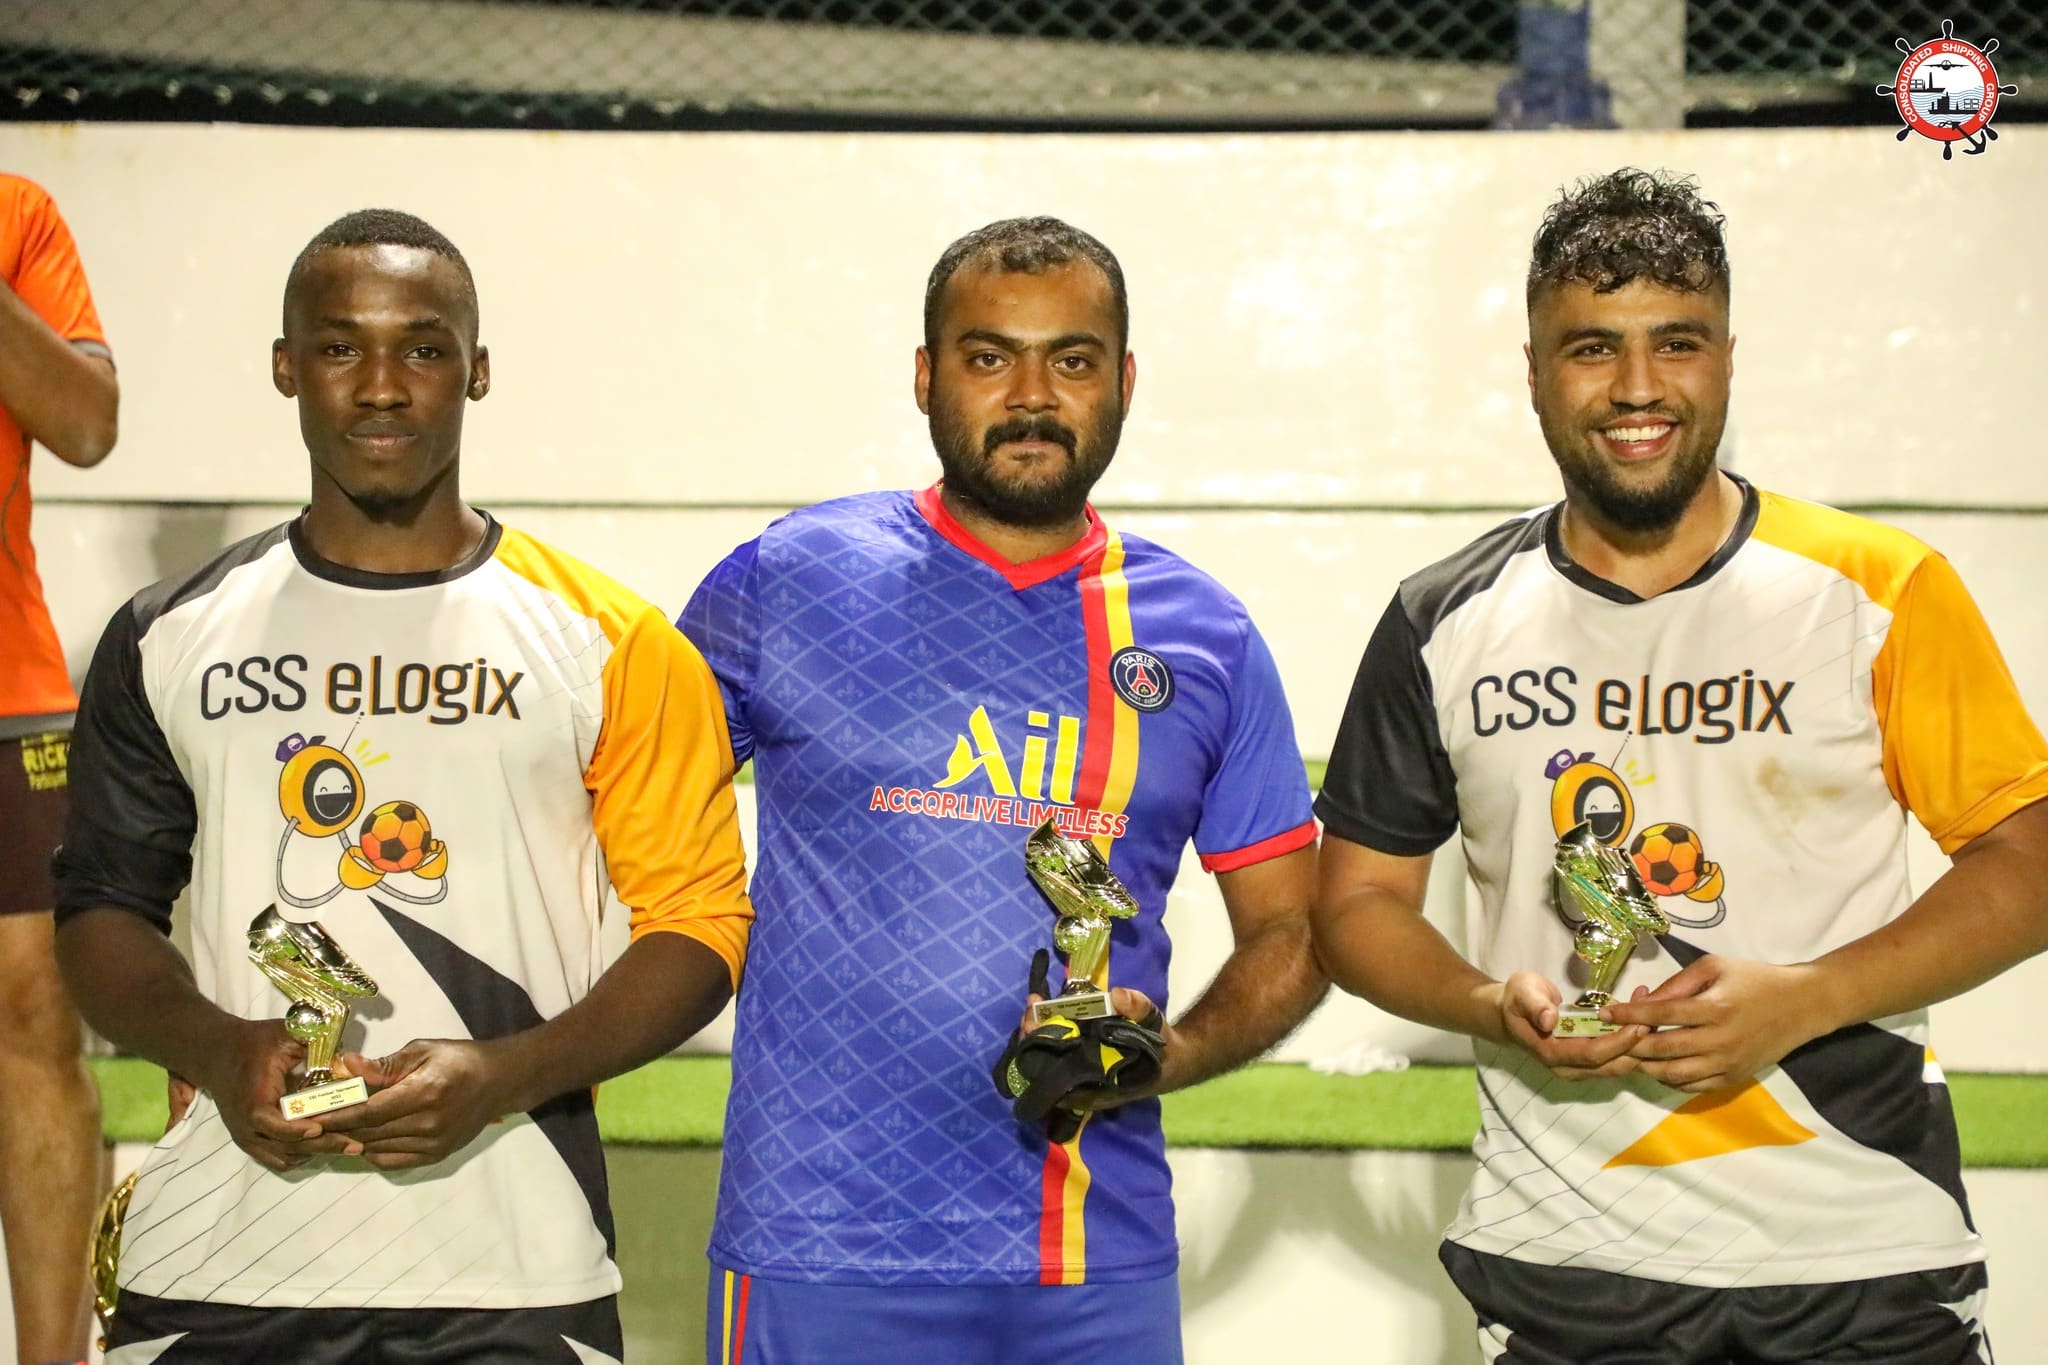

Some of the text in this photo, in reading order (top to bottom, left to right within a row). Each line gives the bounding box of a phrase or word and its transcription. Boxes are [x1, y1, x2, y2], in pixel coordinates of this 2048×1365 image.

[200, 654, 525, 725] CSS eLogix
[1121, 654, 1156, 669] PARIS
[1471, 666, 1796, 744] CSS eLogix
[958, 793, 1012, 825] LIVE
[1013, 800, 1130, 838] LIMITLESS
